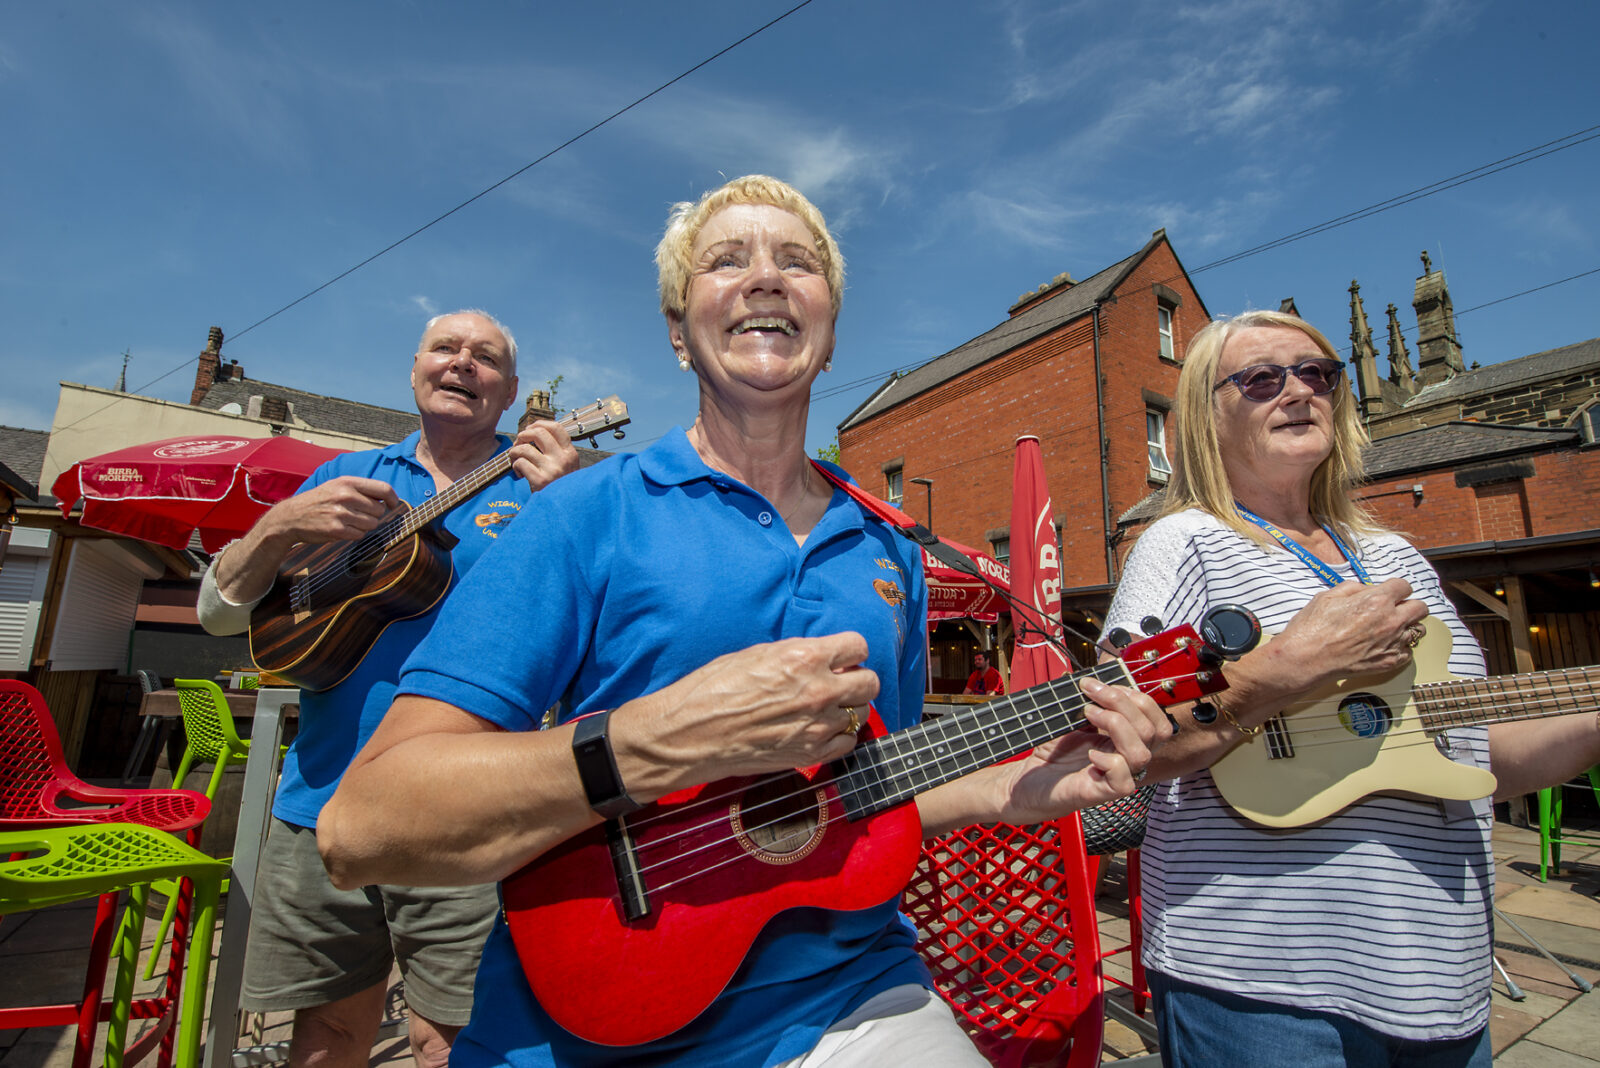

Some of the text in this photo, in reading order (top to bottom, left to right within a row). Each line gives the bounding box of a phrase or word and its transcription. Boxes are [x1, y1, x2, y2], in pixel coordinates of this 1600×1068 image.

[107, 467, 139, 475] BIRRA
[98, 474, 144, 482] MORETTI
[488, 500, 522, 511] WIGAN
[1304, 556, 1321, 572] Laugh
[1319, 569, 1333, 580] and
